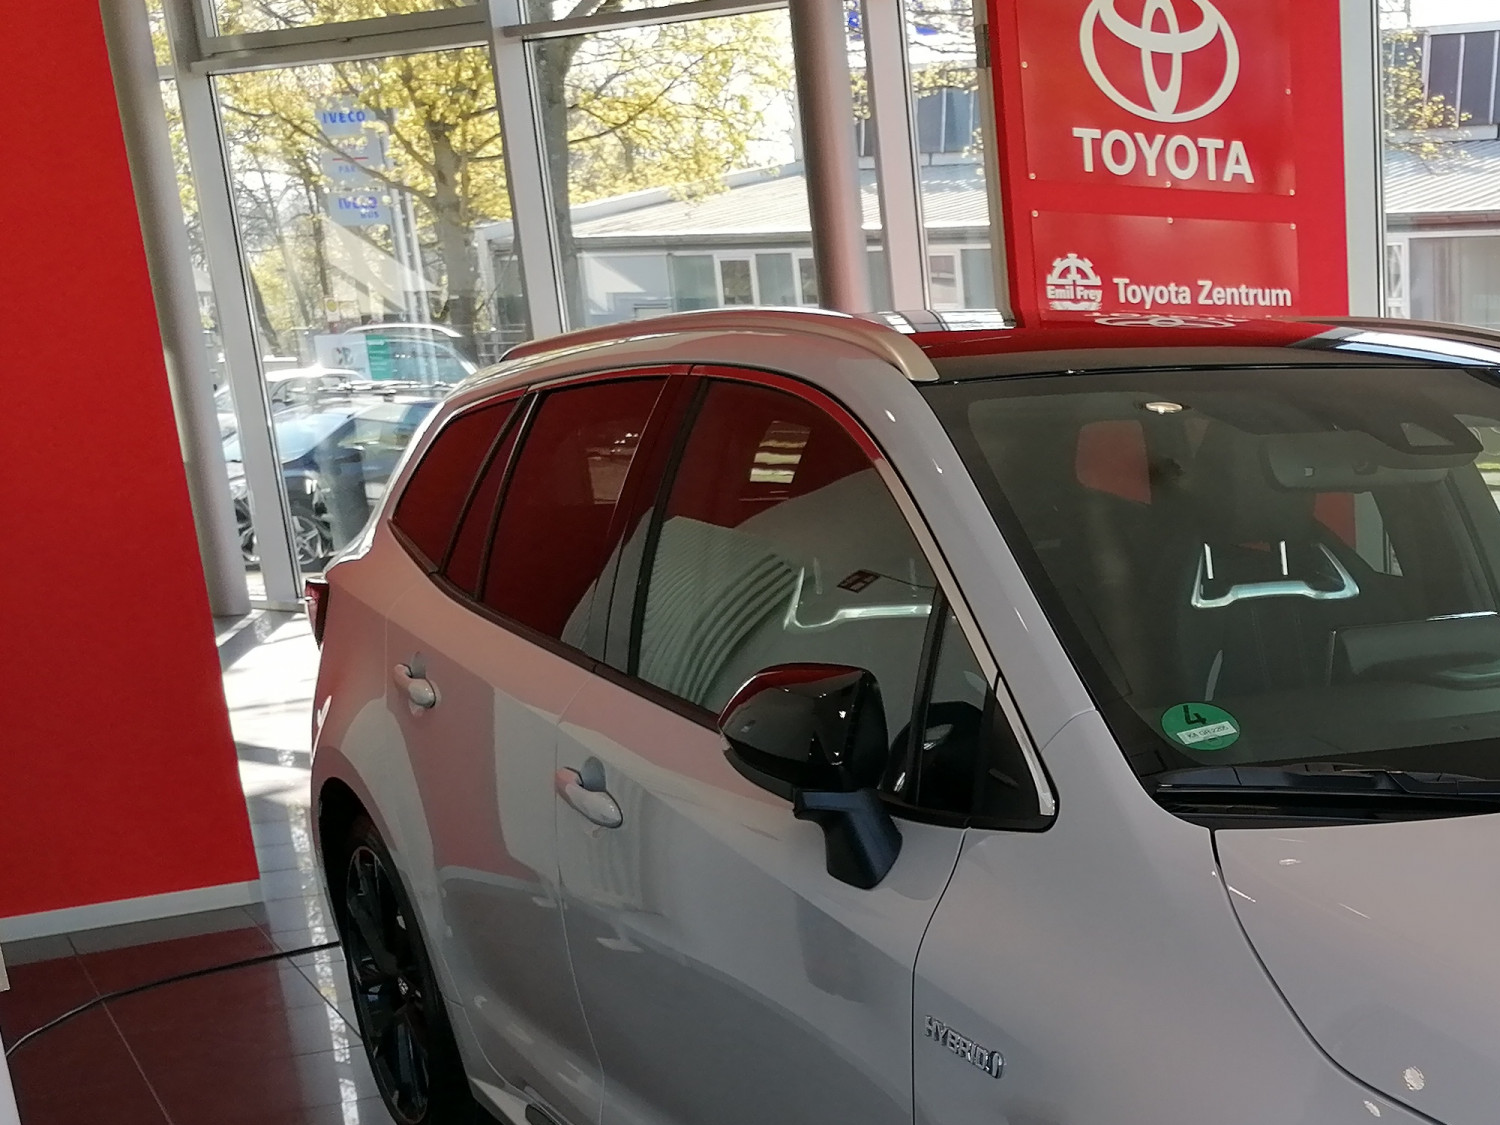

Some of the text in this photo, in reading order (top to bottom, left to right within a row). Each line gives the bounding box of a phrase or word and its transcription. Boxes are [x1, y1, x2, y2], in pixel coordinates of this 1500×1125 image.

[322, 110, 366, 124] IVECO
[1072, 127, 1255, 184] TOYOTA
[1047, 286, 1102, 302] Emil Frey
[1113, 278, 1292, 309] Toyota Zentrum
[1183, 705, 1207, 725] 4
[925, 1015, 989, 1071] HYBRID
